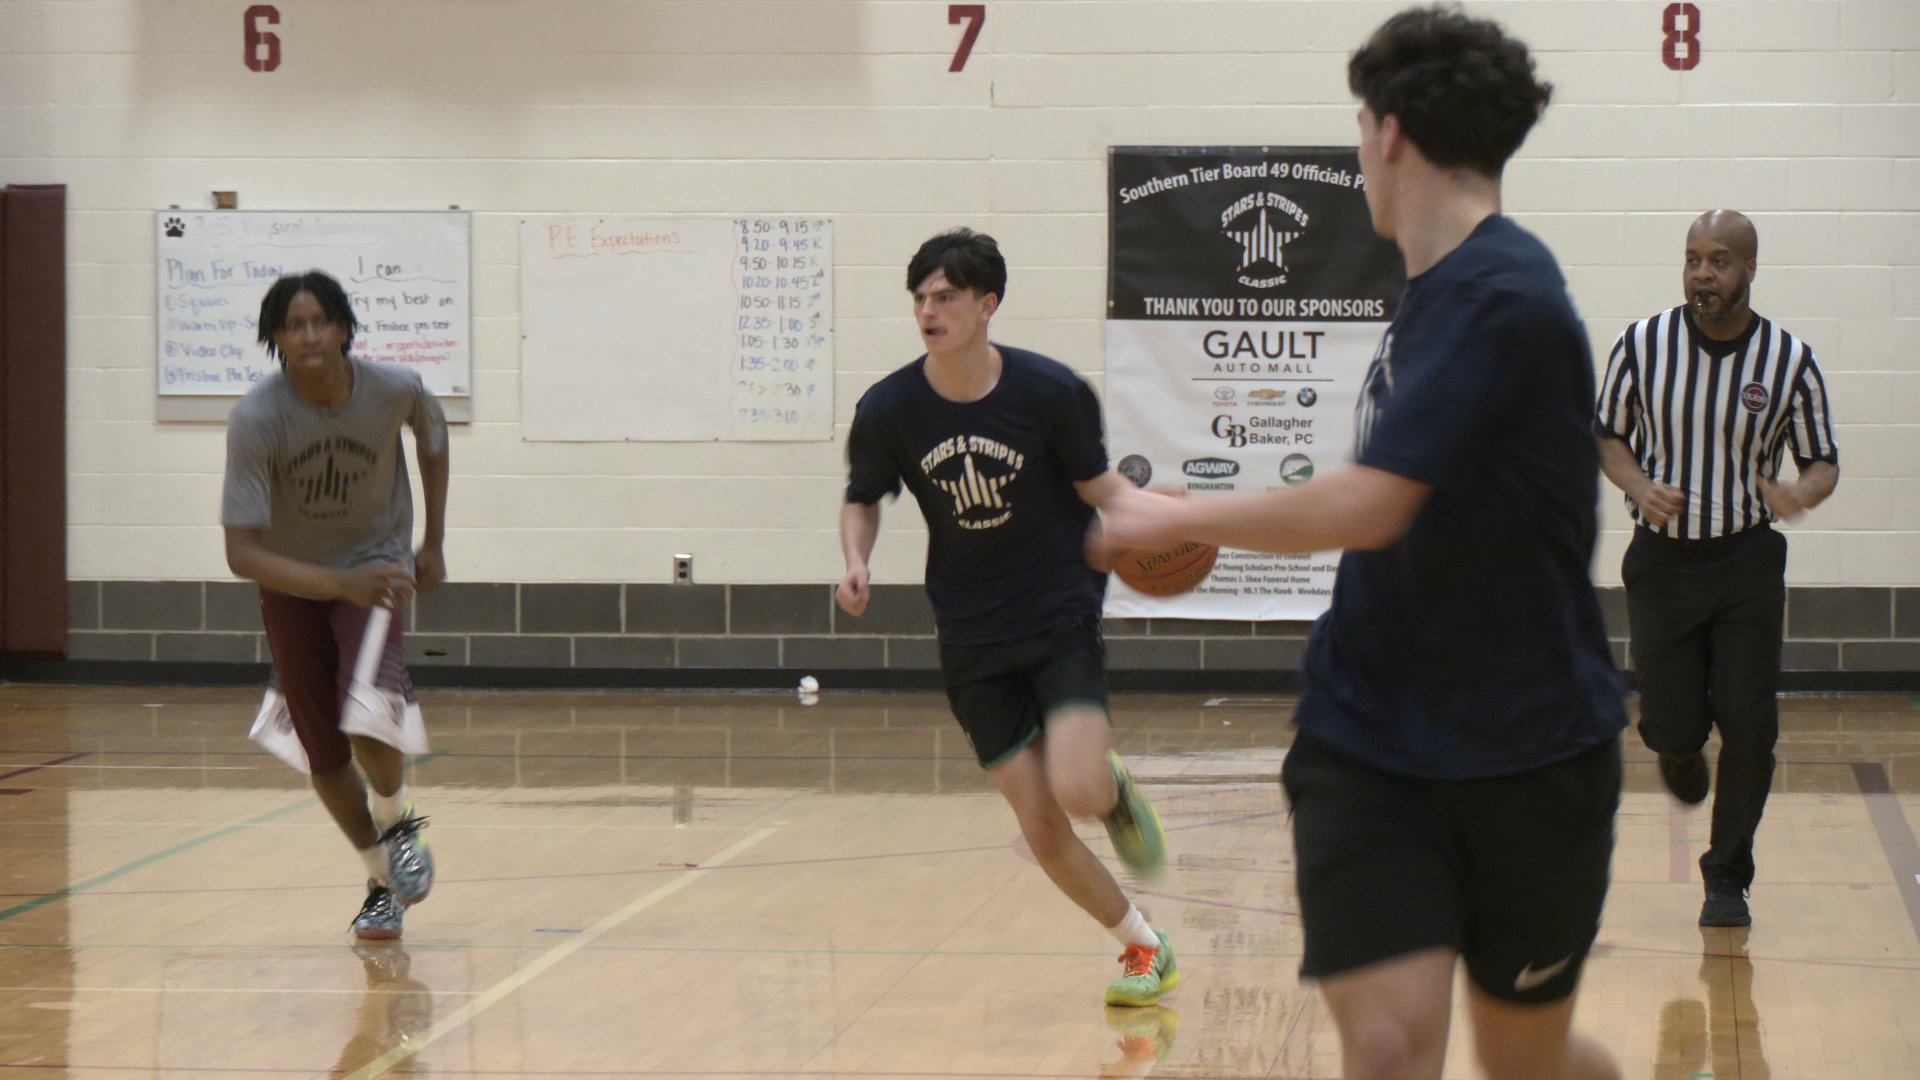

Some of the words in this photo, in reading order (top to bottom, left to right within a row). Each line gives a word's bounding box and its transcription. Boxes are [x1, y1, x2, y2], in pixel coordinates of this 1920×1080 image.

[244, 5, 281, 72] 6
[948, 4, 985, 72] 7
[1662, 3, 1700, 70] 8
[1119, 173, 1189, 204] Southern
[1190, 167, 1220, 184] Tier
[1222, 161, 1267, 180] Board
[1270, 163, 1289, 178] 49
[1292, 163, 1351, 188] Officials
[1221, 193, 1255, 229] STARS
[1256, 191, 1264, 207] &
[1266, 192, 1309, 228] STRIPES
[590, 224, 681, 252] Expectations
[166, 258, 205, 282] Plan
[375, 263, 402, 277] can
[1238, 275, 1287, 289] CLASSIC
[376, 296, 398, 311] my
[402, 291, 430, 306] best
[438, 296, 454, 308] on
[1144, 297, 1199, 316] THANK
[1201, 298, 1234, 316] YOU
[1237, 298, 1258, 316] TO
[1261, 299, 1296, 317] OUR
[1298, 299, 1384, 317] SPONSORS
[432, 321, 450, 331] test
[1203, 330, 1325, 359] GAULT
[1213, 363, 1260, 373] AUTO
[1267, 363, 1313, 373] MALL
[1249, 416, 1313, 430] Gallagher
[1249, 433, 1290, 446] Baker,
[1294, 433, 1313, 445] PC
[921, 437, 955, 475] STARS
[956, 435, 967, 454] &
[968, 435, 1024, 471] STRIPES
[1185, 462, 1236, 475] AGWAY
[1187, 482, 1235, 491] BINGHAMTON
[958, 511, 1012, 530] CLASSIC
[1231, 552, 1274, 560] Construction
[1222, 564, 1243, 573] Young
[1274, 564, 1311, 572] Pre-School
[1211, 575, 1237, 583] Thomas
[1245, 575, 1261, 583] Shea
[1290, 576, 1310, 584] Home
[1209, 587, 1238, 595] Morning
[1273, 587, 1292, 595] Hawk
[1298, 587, 1331, 596] Weekdays
